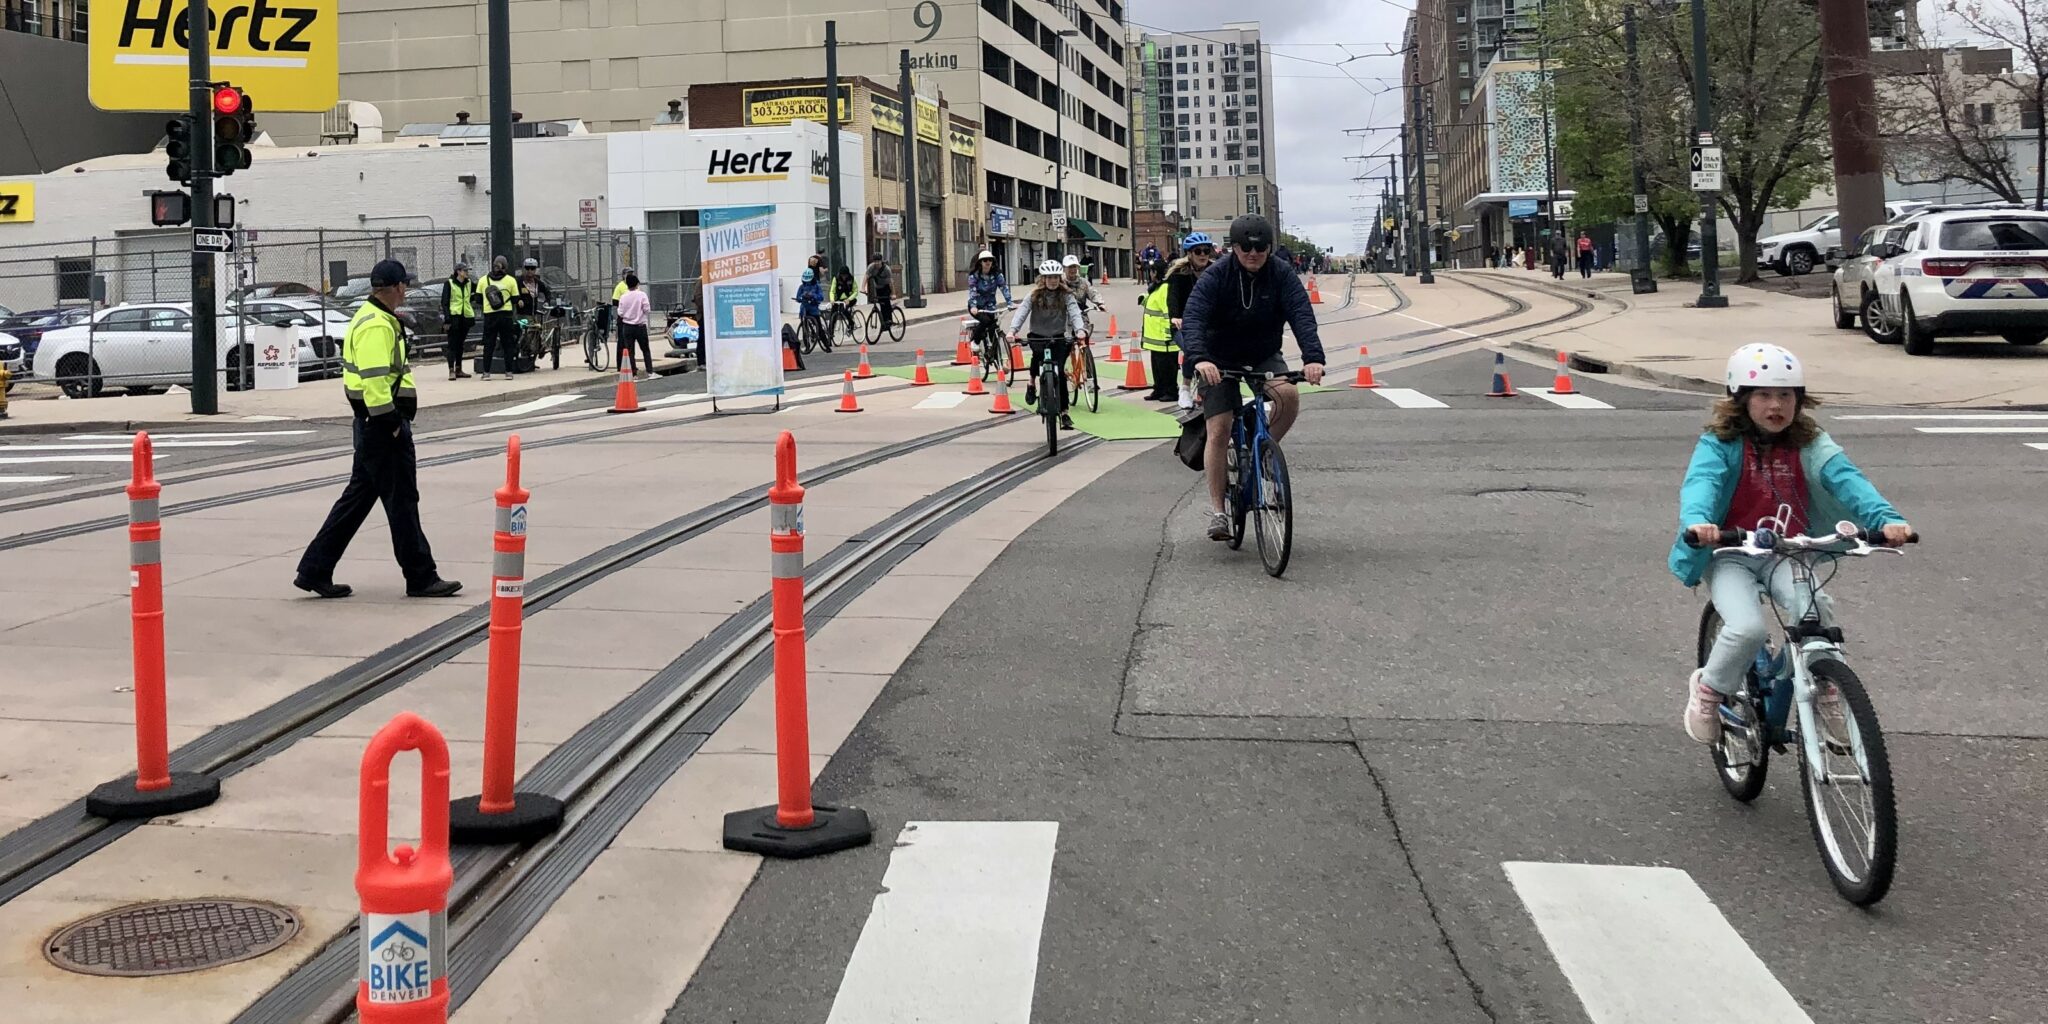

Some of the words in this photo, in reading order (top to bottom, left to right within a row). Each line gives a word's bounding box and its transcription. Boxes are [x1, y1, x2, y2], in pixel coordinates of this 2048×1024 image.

[913, 0, 942, 43] 9
[899, 51, 958, 70] arking
[753, 103, 827, 117] 303.295.ROCK
[708, 147, 793, 175] Hertz
[811, 149, 829, 177] Hert
[1053, 218, 1066, 226] 30
[709, 267, 732, 280] WIN
[735, 259, 772, 274] PRIZES
[714, 254, 749, 270] ENTER
[752, 251, 766, 261] TO
[370, 960, 428, 990] BIKE
